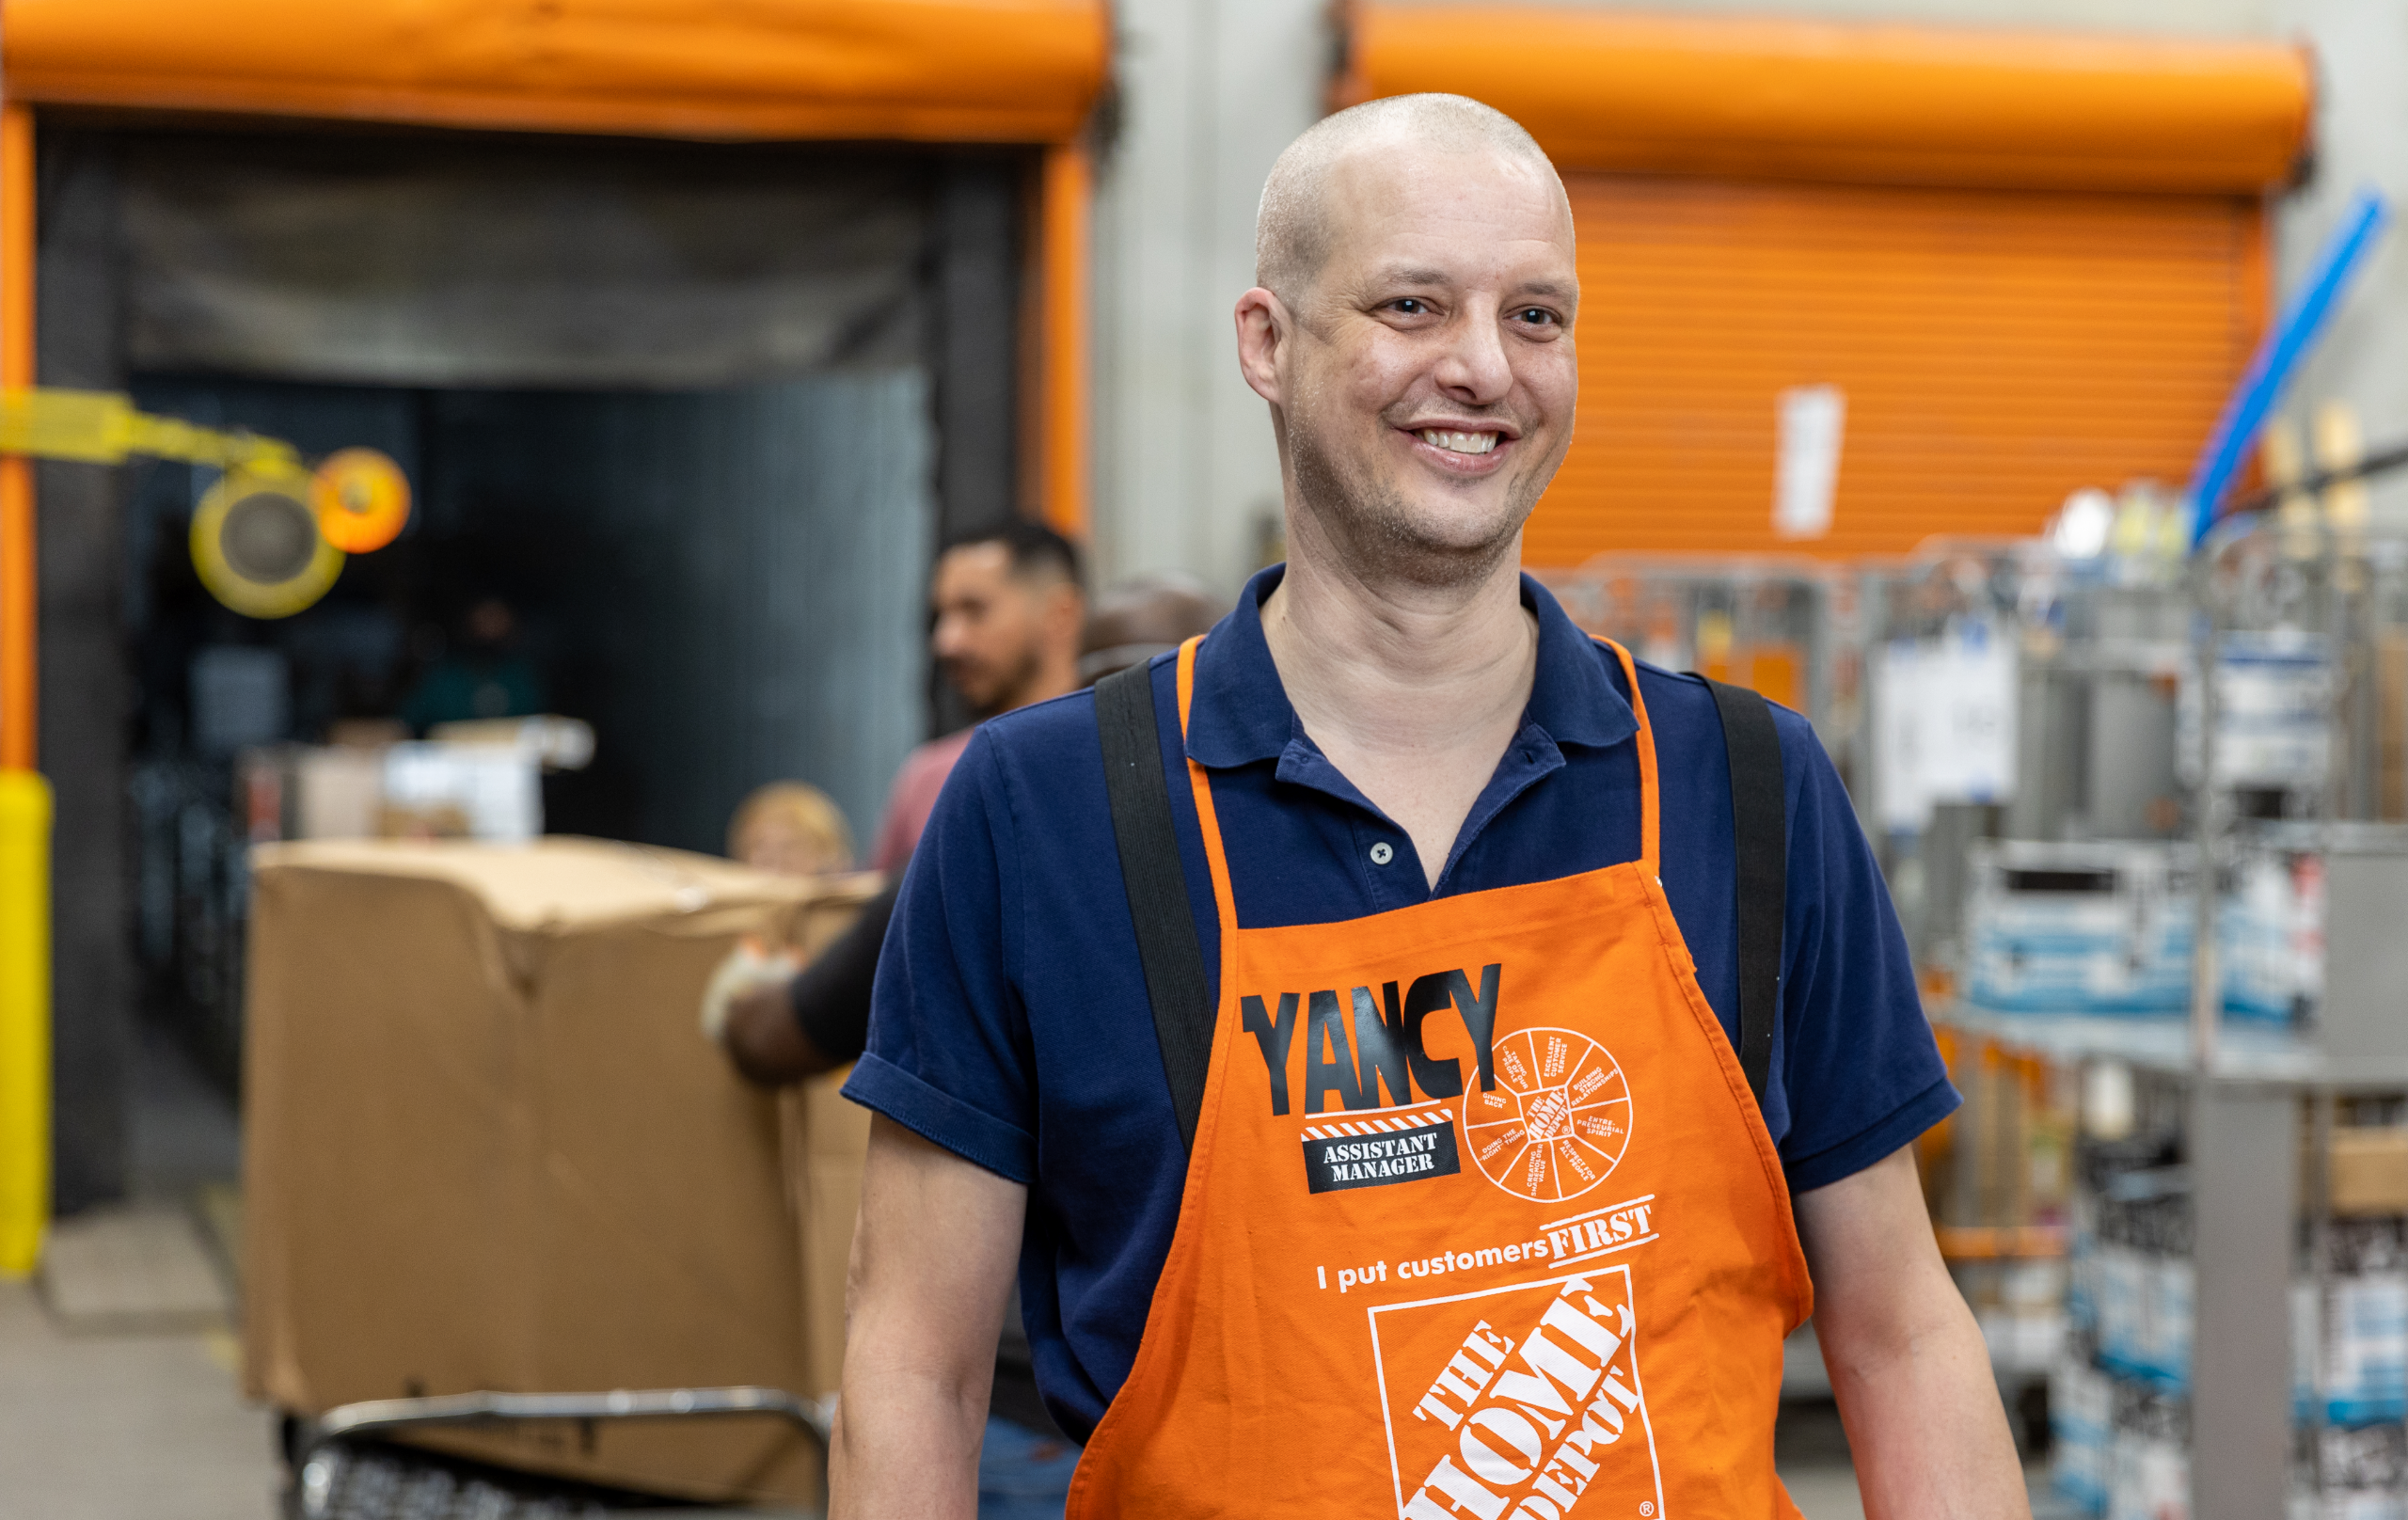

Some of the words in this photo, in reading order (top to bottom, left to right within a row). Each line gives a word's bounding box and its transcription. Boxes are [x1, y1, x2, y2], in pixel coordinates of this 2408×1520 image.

[1241, 963, 1501, 1116] YANCY
[1502, 1045, 1513, 1064] CARE
[1512, 1064, 1519, 1073] OF
[1517, 1074, 1529, 1089] OUR
[1502, 1057, 1519, 1084] PEOPLE
[1511, 1051, 1527, 1076] TAKING
[1544, 1036, 1555, 1077] EXCELLENT
[1550, 1037, 1561, 1077] CUSTOMER
[1558, 1043, 1567, 1073] SERVICE
[1571, 1068, 1619, 1106] RELATIONSHIPS
[1573, 1067, 1602, 1090] BUILDING
[1579, 1072, 1605, 1093] STRONG
[1482, 1093, 1506, 1103] GIVING
[1484, 1099, 1503, 1109] BACK
[1527, 1096, 1545, 1117] THE
[1481, 1137, 1502, 1153] DOING
[1502, 1129, 1516, 1140] THE
[1504, 1130, 1525, 1145] THING
[1576, 1119, 1624, 1134] PRENEURIAL
[1586, 1128, 1611, 1137] SPIRIT
[1323, 1132, 1437, 1164] ASSISTANT
[1562, 1139, 1586, 1166] RESPECT
[1584, 1166, 1596, 1180] FOR
[1331, 1153, 1434, 1182] MANAGER
[1527, 1150, 1537, 1187] CREATING
[1530, 1144, 1544, 1196] SHAREHOLDER
[1560, 1147, 1570, 1159] ALL
[1569, 1158, 1589, 1181] PEOPLE
[1317, 1266, 1326, 1289] I
[1338, 1260, 1387, 1293] put
[1397, 1238, 1548, 1279] customers
[1547, 1205, 1652, 1259] FIRST
[1412, 1319, 1515, 1431] THE
[1400, 1278, 1633, 1520] HOME
